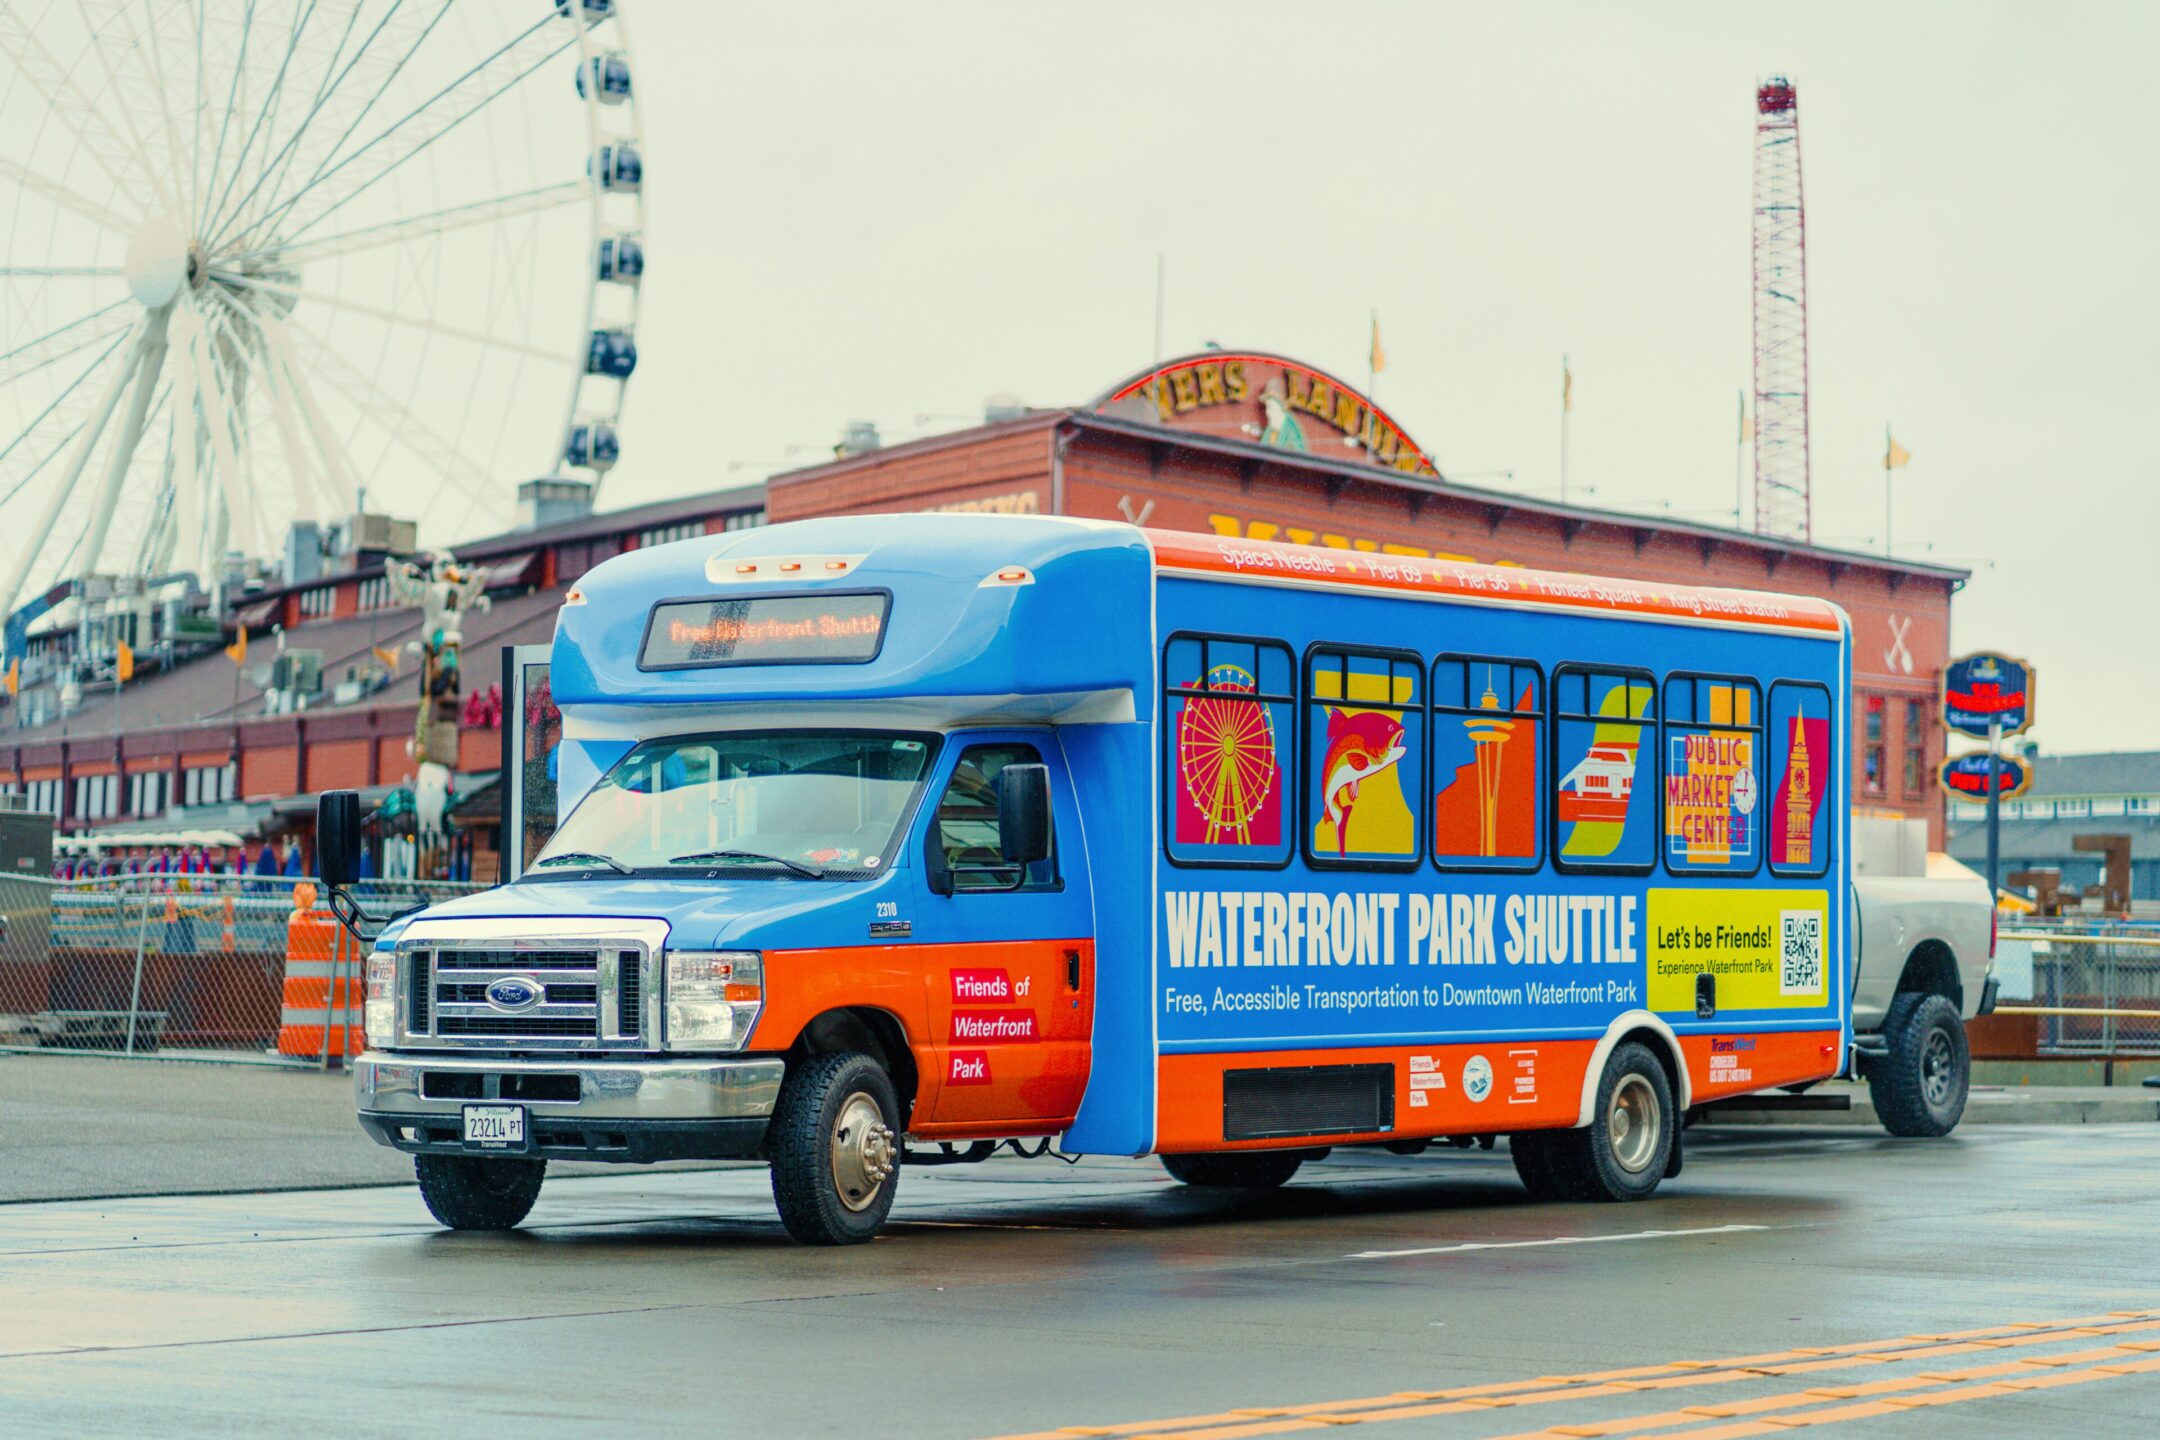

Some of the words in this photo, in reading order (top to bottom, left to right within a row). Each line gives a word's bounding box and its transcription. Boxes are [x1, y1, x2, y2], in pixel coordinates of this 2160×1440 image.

[1217, 543, 1274, 570] Space
[1272, 549, 1336, 575] Needle
[1364, 558, 1399, 581] Pier
[1402, 564, 1422, 583] 69
[1453, 568, 1487, 590] Pier
[1487, 574, 1510, 592] 56
[1536, 576, 1592, 599] Pioneer
[1595, 581, 1643, 605] Square
[1667, 592, 1702, 615] King
[1701, 596, 1742, 614] Street
[1742, 598, 1789, 618] Station
[671, 618, 711, 643] Free
[715, 617, 814, 641] Waterfront
[1685, 735, 1742, 766] PUBLIC
[1668, 773, 1734, 808] MARKET
[1682, 814, 1746, 844] CENTER
[876, 901, 897, 918] 2310
[1165, 891, 1400, 968] WATERFRONT
[1408, 893, 1497, 966] PARK
[1504, 894, 1637, 965] SHUTTLE
[1695, 925, 1712, 949] be
[1717, 925, 1772, 949] Friends!
[1657, 960, 1704, 977] Experience
[1706, 959, 1753, 974] Waterfront
[1755, 958, 1773, 973] Park
[498, 986, 523, 1000] Ford
[955, 975, 1008, 997] Friends
[1015, 975, 1031, 996] of
[1166, 987, 1207, 1016] Free,
[1212, 984, 1300, 1011] Accessible
[1304, 983, 1418, 1014] Transportation
[1423, 985, 1438, 1006] to
[1443, 982, 1521, 1006] Downtown
[1525, 980, 1603, 1005] Waterfront
[1607, 979, 1637, 1002] Park
[955, 1016, 1032, 1037] Waterfront
[1711, 1037, 1756, 1052] TransWest
[952, 1058, 984, 1079] Park
[470, 1118, 506, 1138] 23214
[510, 1120, 521, 1134] PT
